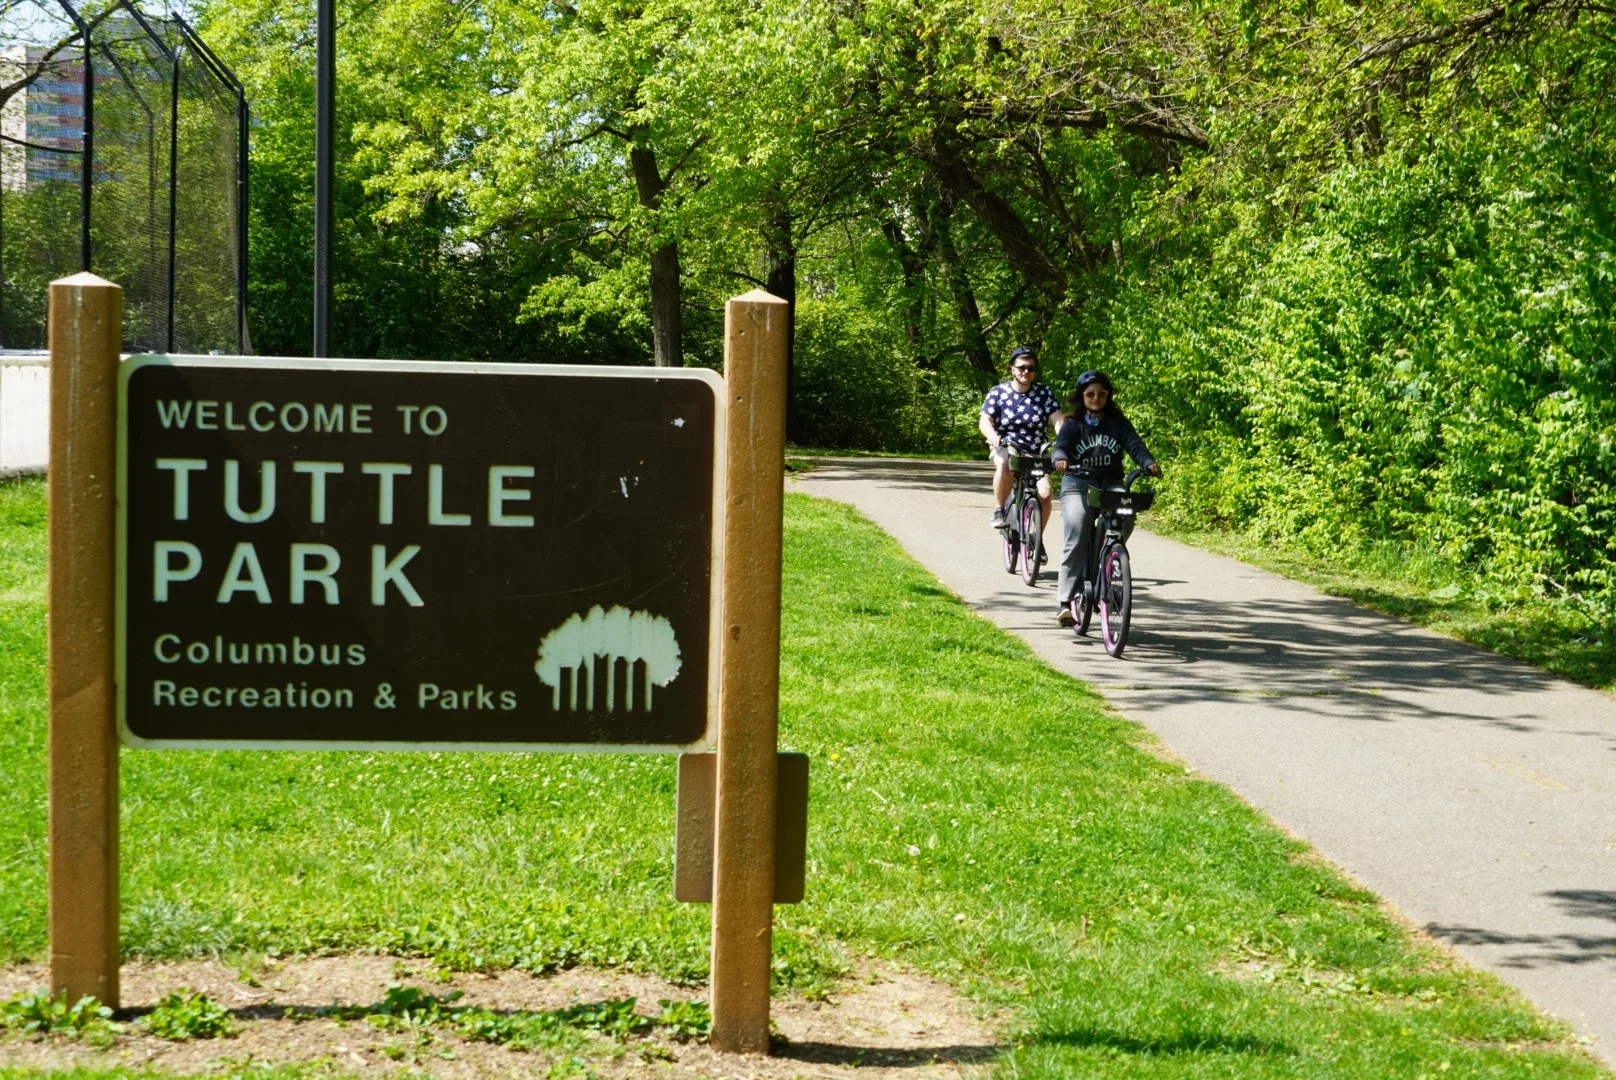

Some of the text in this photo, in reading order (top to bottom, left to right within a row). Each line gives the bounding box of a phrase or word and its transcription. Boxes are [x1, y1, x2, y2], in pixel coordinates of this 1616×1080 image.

[155, 400, 448, 436] WELCOME TO
[1082, 454, 1111, 467] OHIO
[156, 458, 535, 526] TUTTLE
[153, 541, 425, 607] PARK
[154, 634, 366, 665] Columbus
[153, 680, 517, 712] Recreation & Parks
